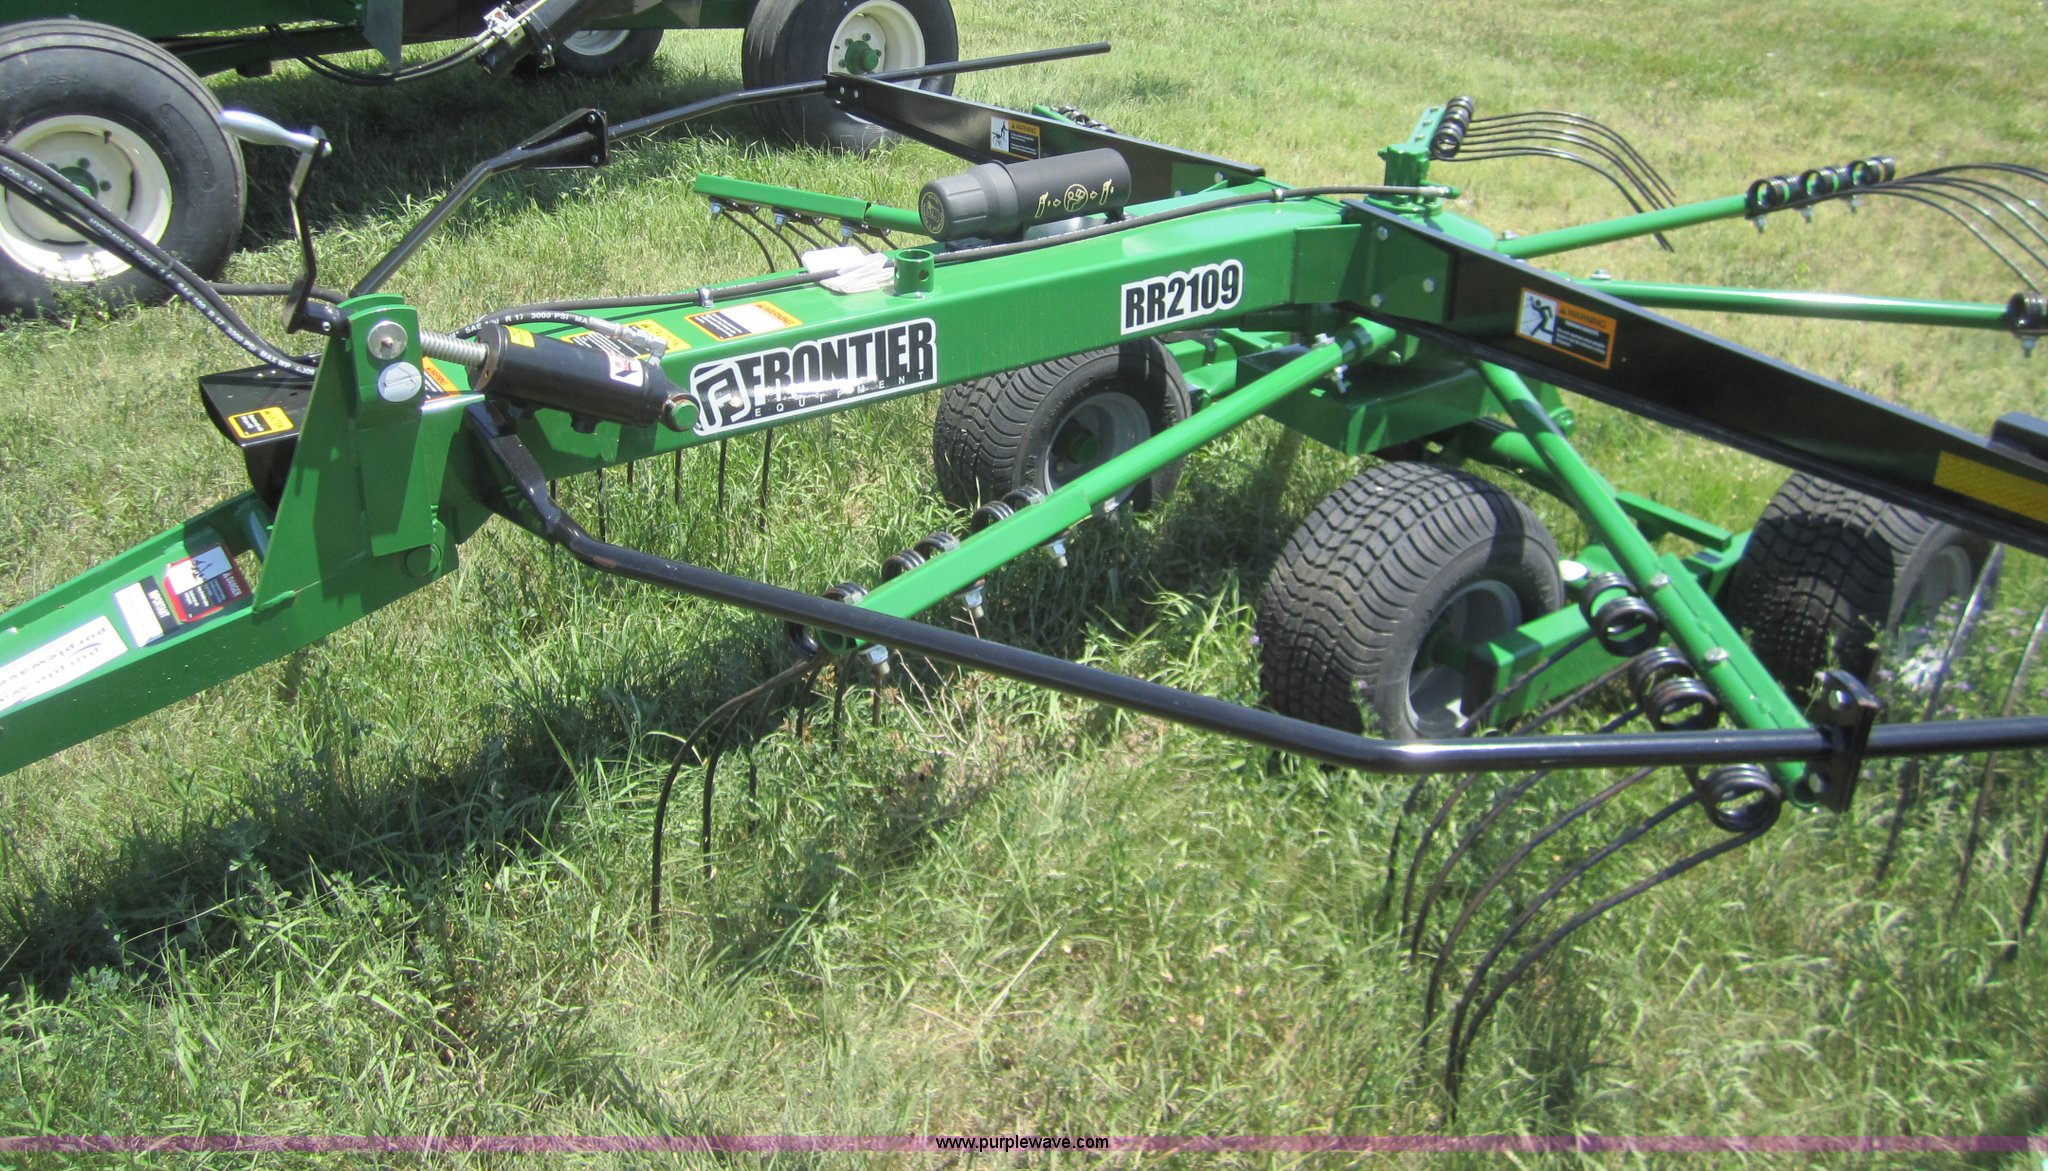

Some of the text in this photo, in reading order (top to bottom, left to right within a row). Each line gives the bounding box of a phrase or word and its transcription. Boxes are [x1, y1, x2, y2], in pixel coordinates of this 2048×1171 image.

[1125, 263, 1240, 329] RR2109
[465, 322, 482, 334] SAE
[505, 315, 512, 323] R
[554, 312, 569, 320] PSI
[259, 350, 278, 365] MAX
[277, 359, 292, 369] WP
[736, 321, 934, 407] FRONTIER
[755, 371, 925, 417] EQUIPMENT
[224, 575, 243, 598] DANGER
[147, 589, 171, 619] IMPORTANT
